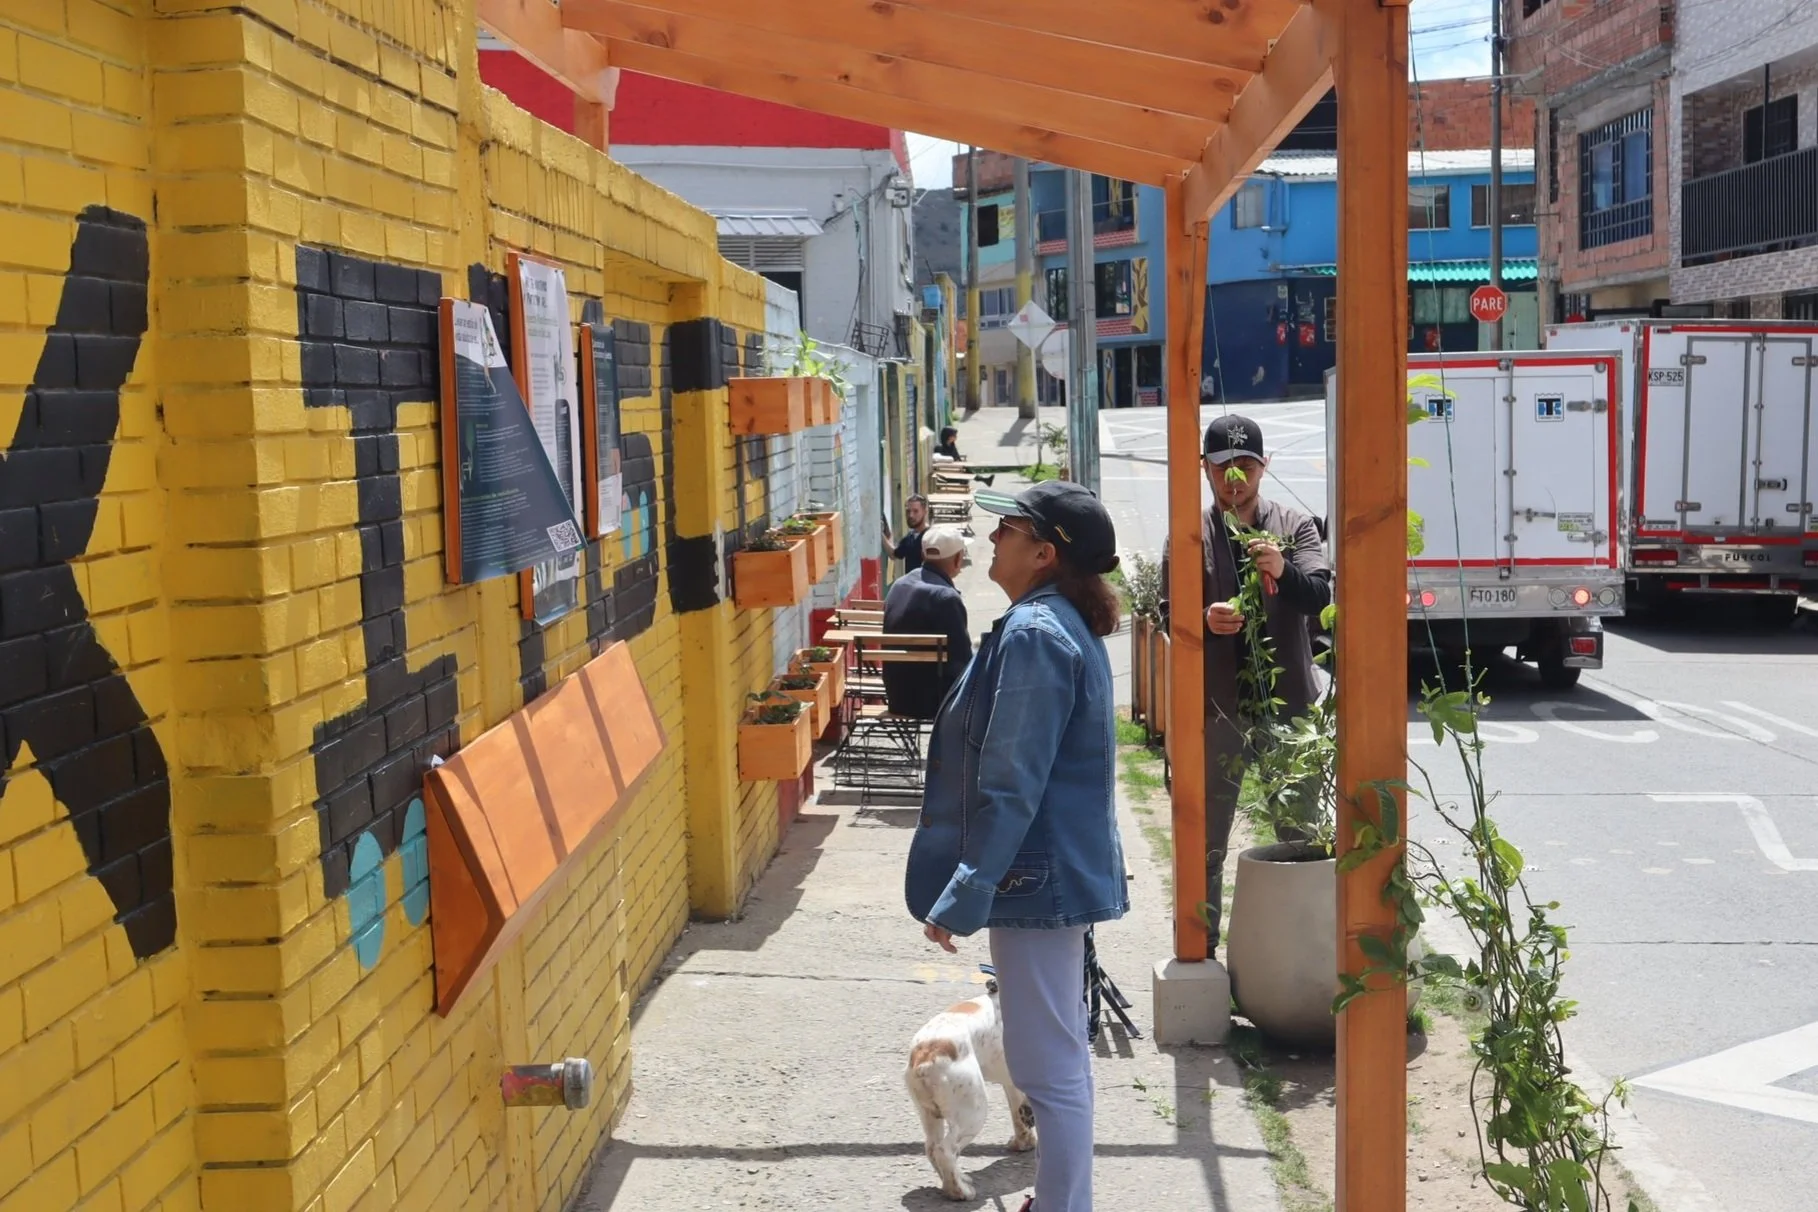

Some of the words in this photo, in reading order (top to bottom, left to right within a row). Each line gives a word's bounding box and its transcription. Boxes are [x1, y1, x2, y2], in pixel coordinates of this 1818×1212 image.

[1473, 297, 1503, 311] PARE
[1648, 371, 1665, 381] KSP
[1667, 371, 1684, 382] 525
[1496, 590, 1516, 602] 180
